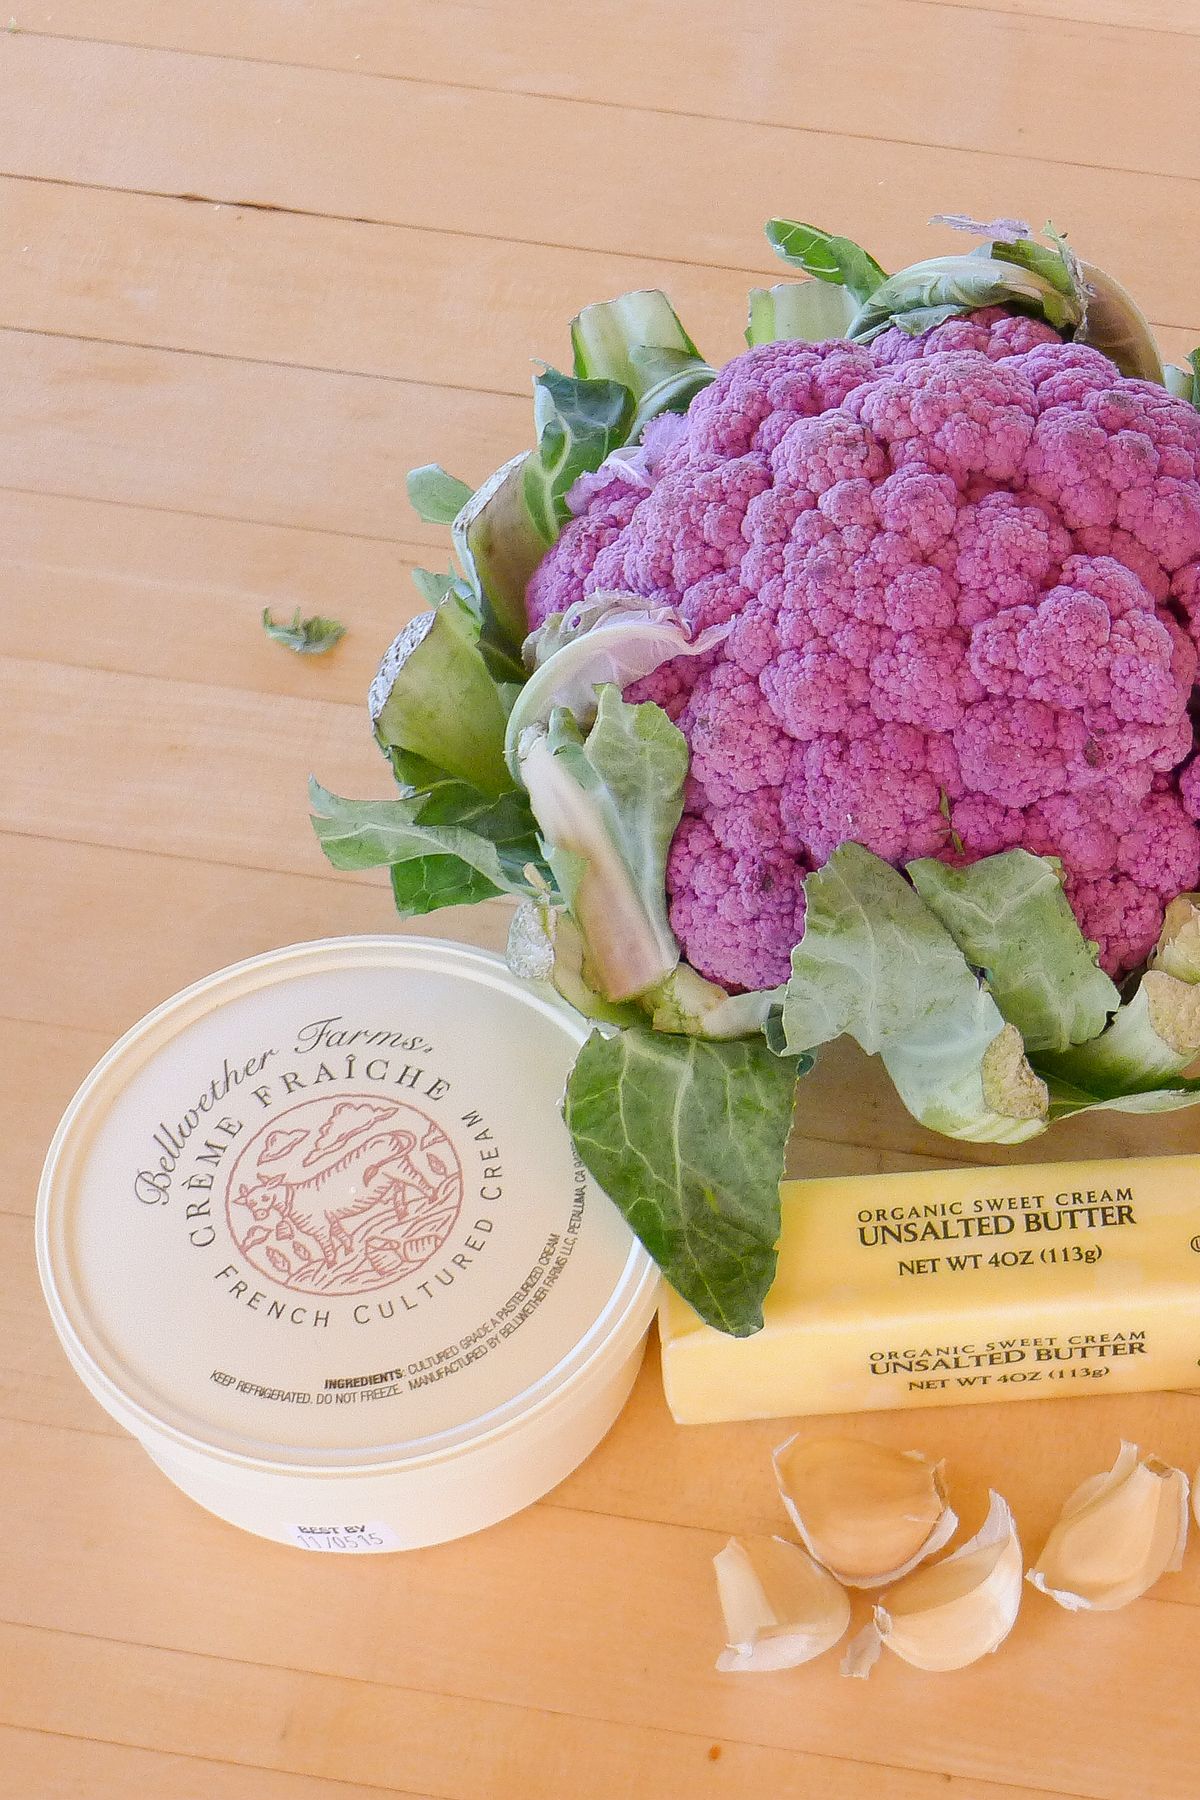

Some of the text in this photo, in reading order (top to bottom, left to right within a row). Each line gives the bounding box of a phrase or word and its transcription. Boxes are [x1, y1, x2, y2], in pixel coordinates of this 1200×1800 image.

[135, 1049, 280, 1205] Bellwether
[181, 1054, 451, 1247] CRÈME FRAÎCHE
[214, 1109, 503, 1327] FRENCH CULTURED CREAM
[858, 1187, 1134, 1223] ORGANIC SWEET CREAM
[858, 1204, 1137, 1247] UNSALTED BUTTER
[899, 1244, 1103, 1276] NET WT 4OZ (113g)
[210, 1369, 236, 1387] KEEP
[316, 1393, 333, 1404] DO
[335, 1391, 357, 1404] NOT
[408, 1345, 488, 1391] MANUFACTURED
[486, 1333, 502, 1349] BY
[499, 1286, 549, 1339] BELLWETHER
[543, 1255, 568, 1288] FARMS
[574, 1169, 586, 1183] CA
[407, 1344, 459, 1375] CULTURED
[459, 1322, 493, 1350] GRADE
[490, 1317, 500, 1328] A
[496, 1266, 544, 1320] PASTEURIZED
[538, 1232, 560, 1266] CREAM
[868, 1341, 1148, 1376] UNSALTED BUTTER
[869, 1330, 1146, 1361] ORGANIC SWEET CREAM
[908, 1378, 950, 1391] NET
[956, 1375, 992, 1388] WT
[1048, 1366, 1110, 1380] (113g)
[297, 1524, 366, 1534] BEST BY
